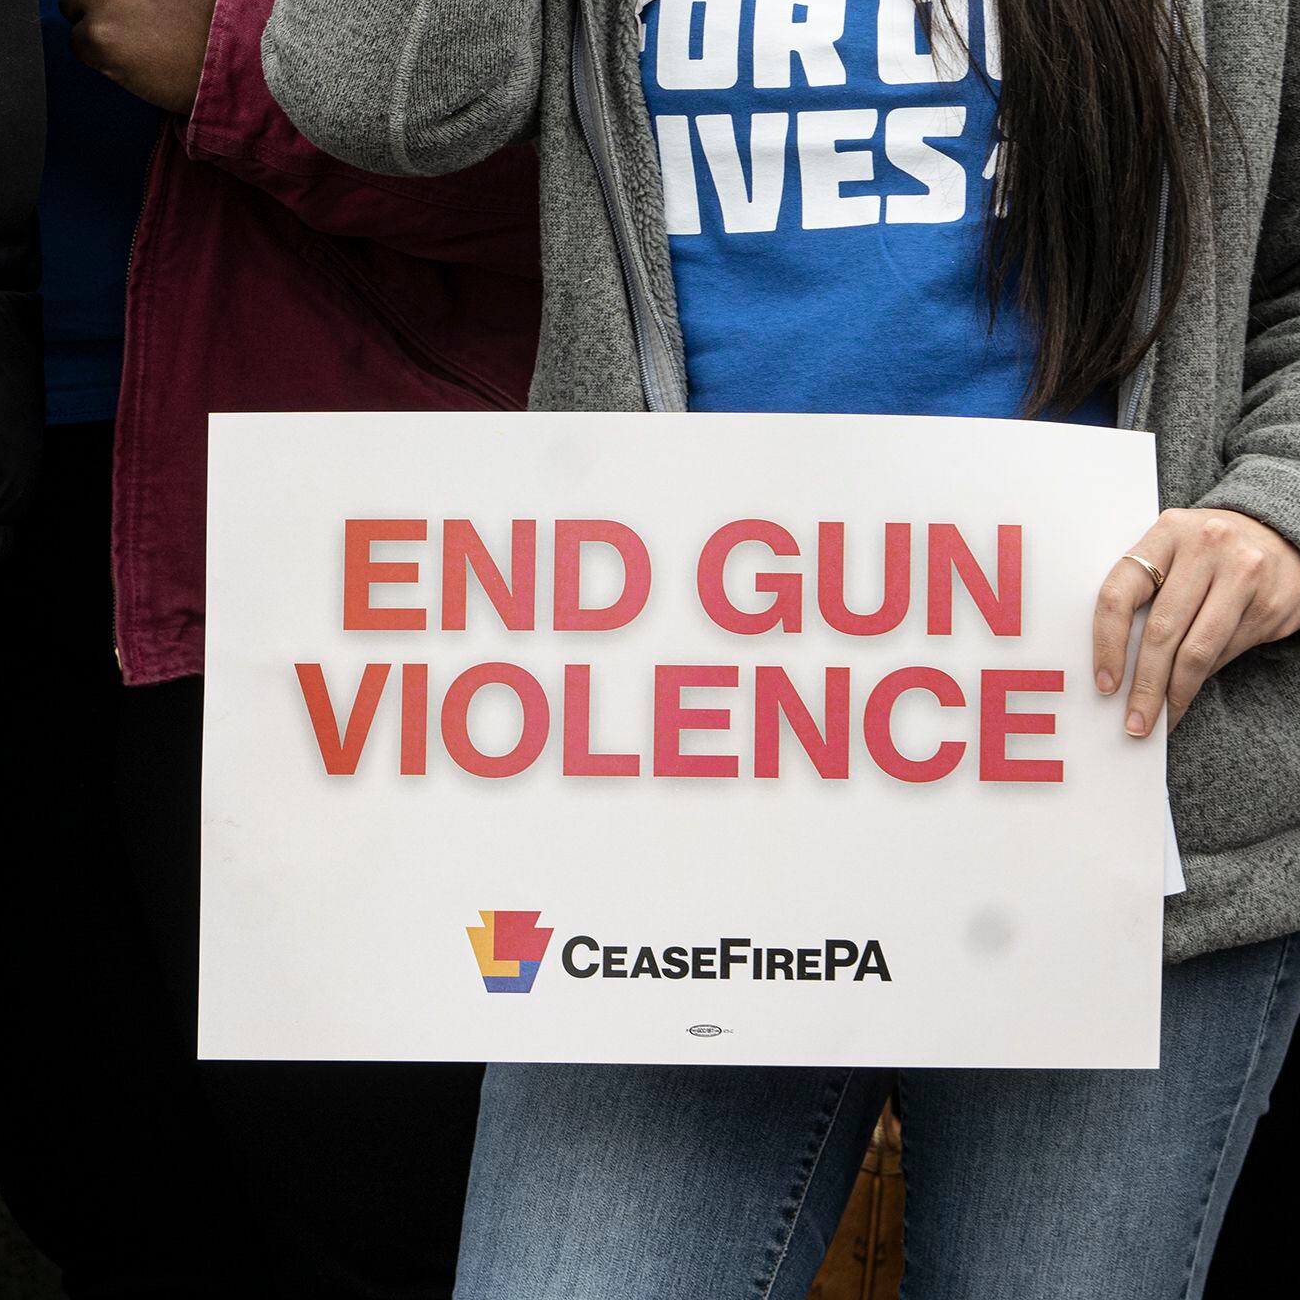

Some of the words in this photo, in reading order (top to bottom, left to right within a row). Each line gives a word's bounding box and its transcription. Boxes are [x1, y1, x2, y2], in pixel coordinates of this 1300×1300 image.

[341, 516, 653, 633] END
[695, 516, 1023, 638] GUN
[293, 660, 1066, 784] VIOLENCE
